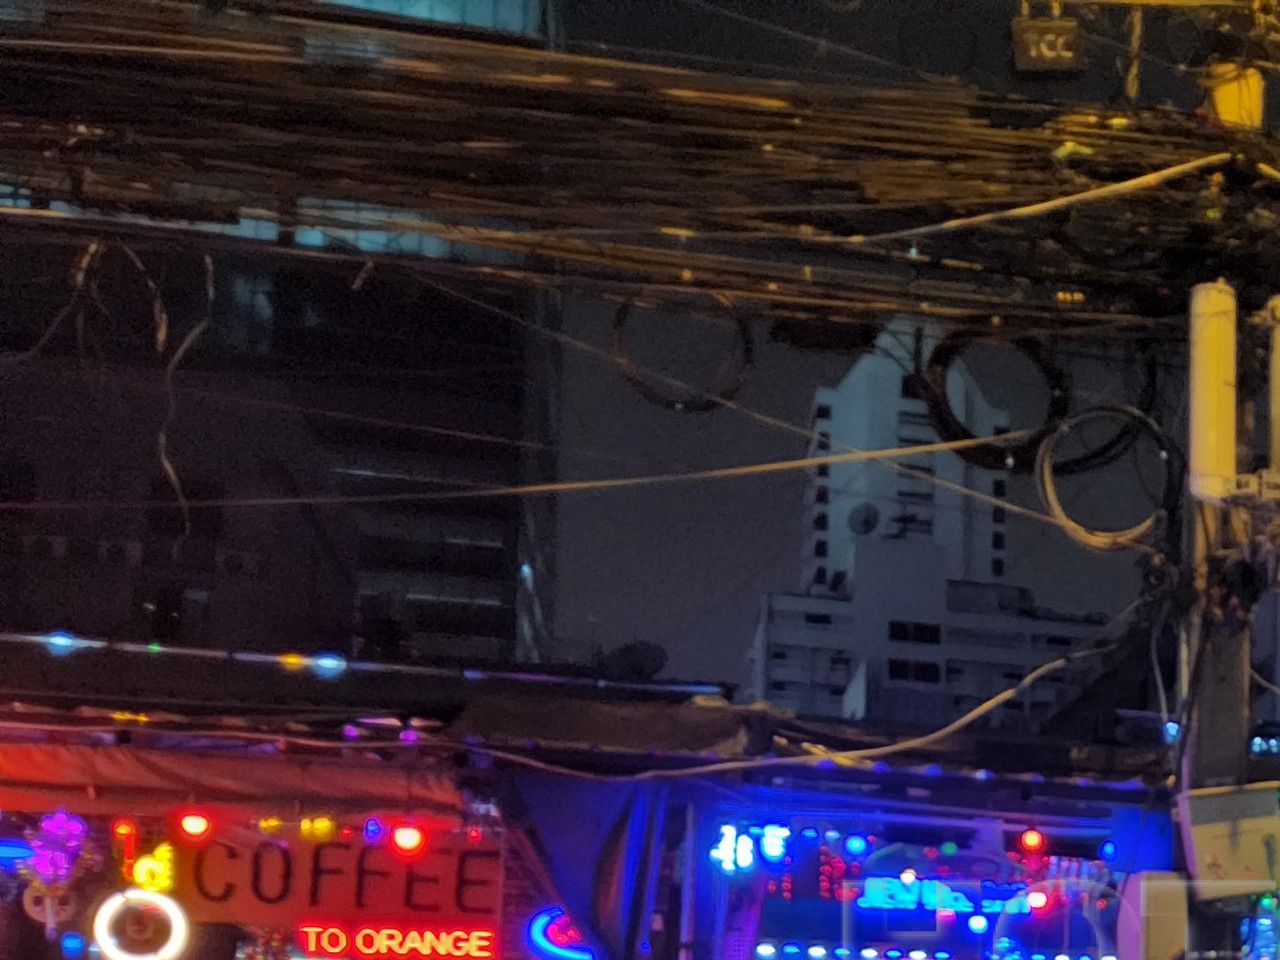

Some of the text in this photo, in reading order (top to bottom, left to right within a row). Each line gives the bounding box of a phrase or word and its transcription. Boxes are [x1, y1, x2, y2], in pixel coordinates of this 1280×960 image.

[193, 841, 500, 914] COFFEE
[300, 926, 494, 958] TO ORANGE
